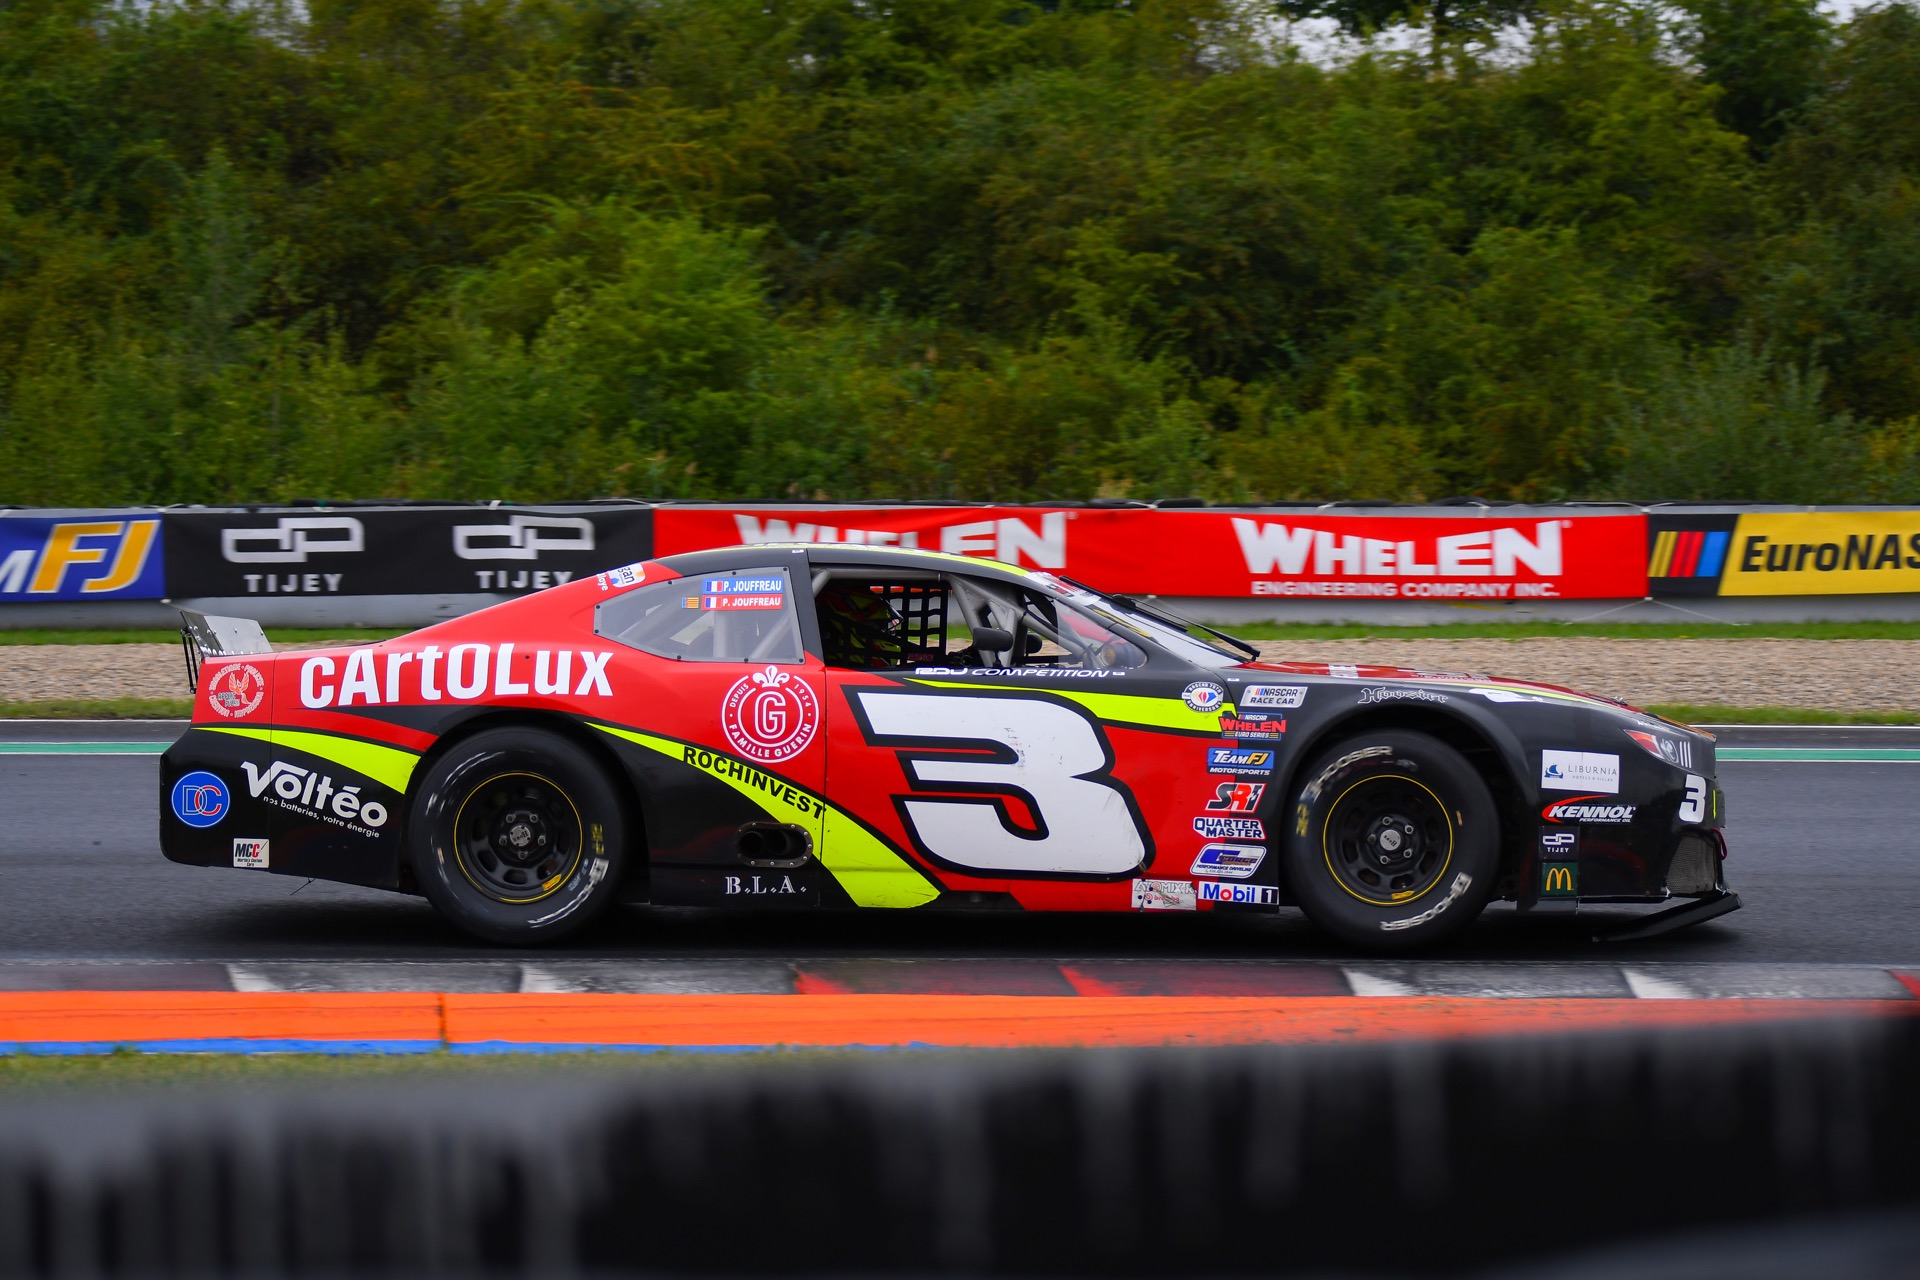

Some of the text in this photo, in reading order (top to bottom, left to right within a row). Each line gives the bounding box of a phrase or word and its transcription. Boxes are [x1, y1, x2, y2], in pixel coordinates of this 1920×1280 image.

[1231, 517, 1562, 576] WHELEN
[243, 574, 343, 593] TIJEY
[723, 580, 782, 592] P. JOUFFREAU
[1251, 581, 1560, 597] ENGINEERING COMPANY INC.
[722, 597, 781, 607] P. JOUFFREAU
[971, 667, 1109, 678] COMPETITION
[729, 683, 812, 708] DEPUIS 1954
[1263, 688, 1298, 697] NASCAR
[754, 690, 787, 739] G
[1219, 717, 1287, 733] WHELEN
[729, 723, 812, 758] FAMILLE GUERIN
[1209, 767, 1271, 776] MOTORSPORTS
[1568, 764, 1617, 775] LIBURNIA
[683, 745, 827, 820] ROCHINVEST
[857, 691, 1146, 875] 3
[1678, 773, 1707, 823] 3
[263, 796, 380, 838] nos batteries, votre énergie
[1548, 805, 1633, 819] KENNOL
[1194, 817, 1260, 832] QUARTER
[1205, 827, 1263, 838] MASTER
[235, 843, 260, 858] MCC
[1203, 883, 1256, 903] Mobil
